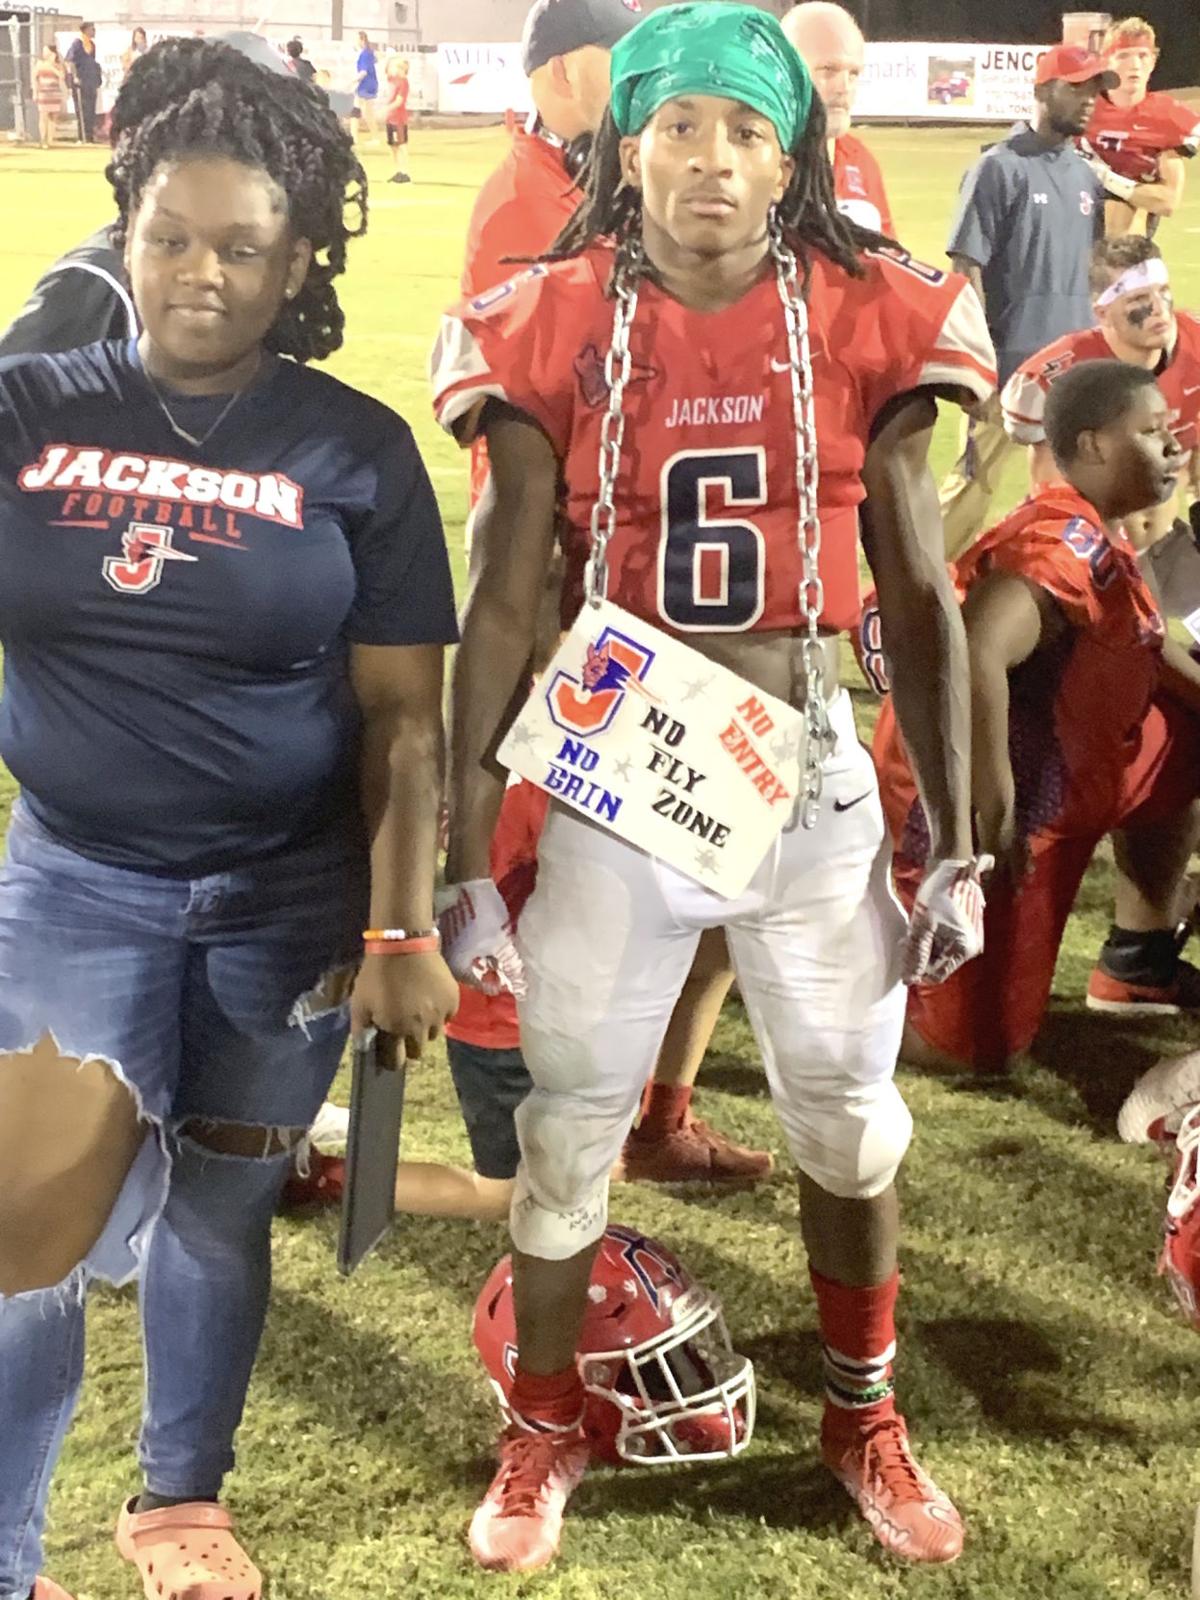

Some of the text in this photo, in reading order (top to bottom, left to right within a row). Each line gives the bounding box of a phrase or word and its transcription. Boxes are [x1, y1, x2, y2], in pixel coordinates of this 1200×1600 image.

[664, 394, 765, 428] JACKSON
[18, 443, 304, 530] JACKSON
[61, 492, 242, 540] FOOTBALL
[656, 445, 768, 634] 6
[640, 705, 687, 748] NO
[736, 694, 776, 738] NO
[555, 735, 601, 773] NO
[645, 743, 707, 794] FLY
[718, 716, 790, 807] ENTRY
[652, 788, 732, 849] ZONE
